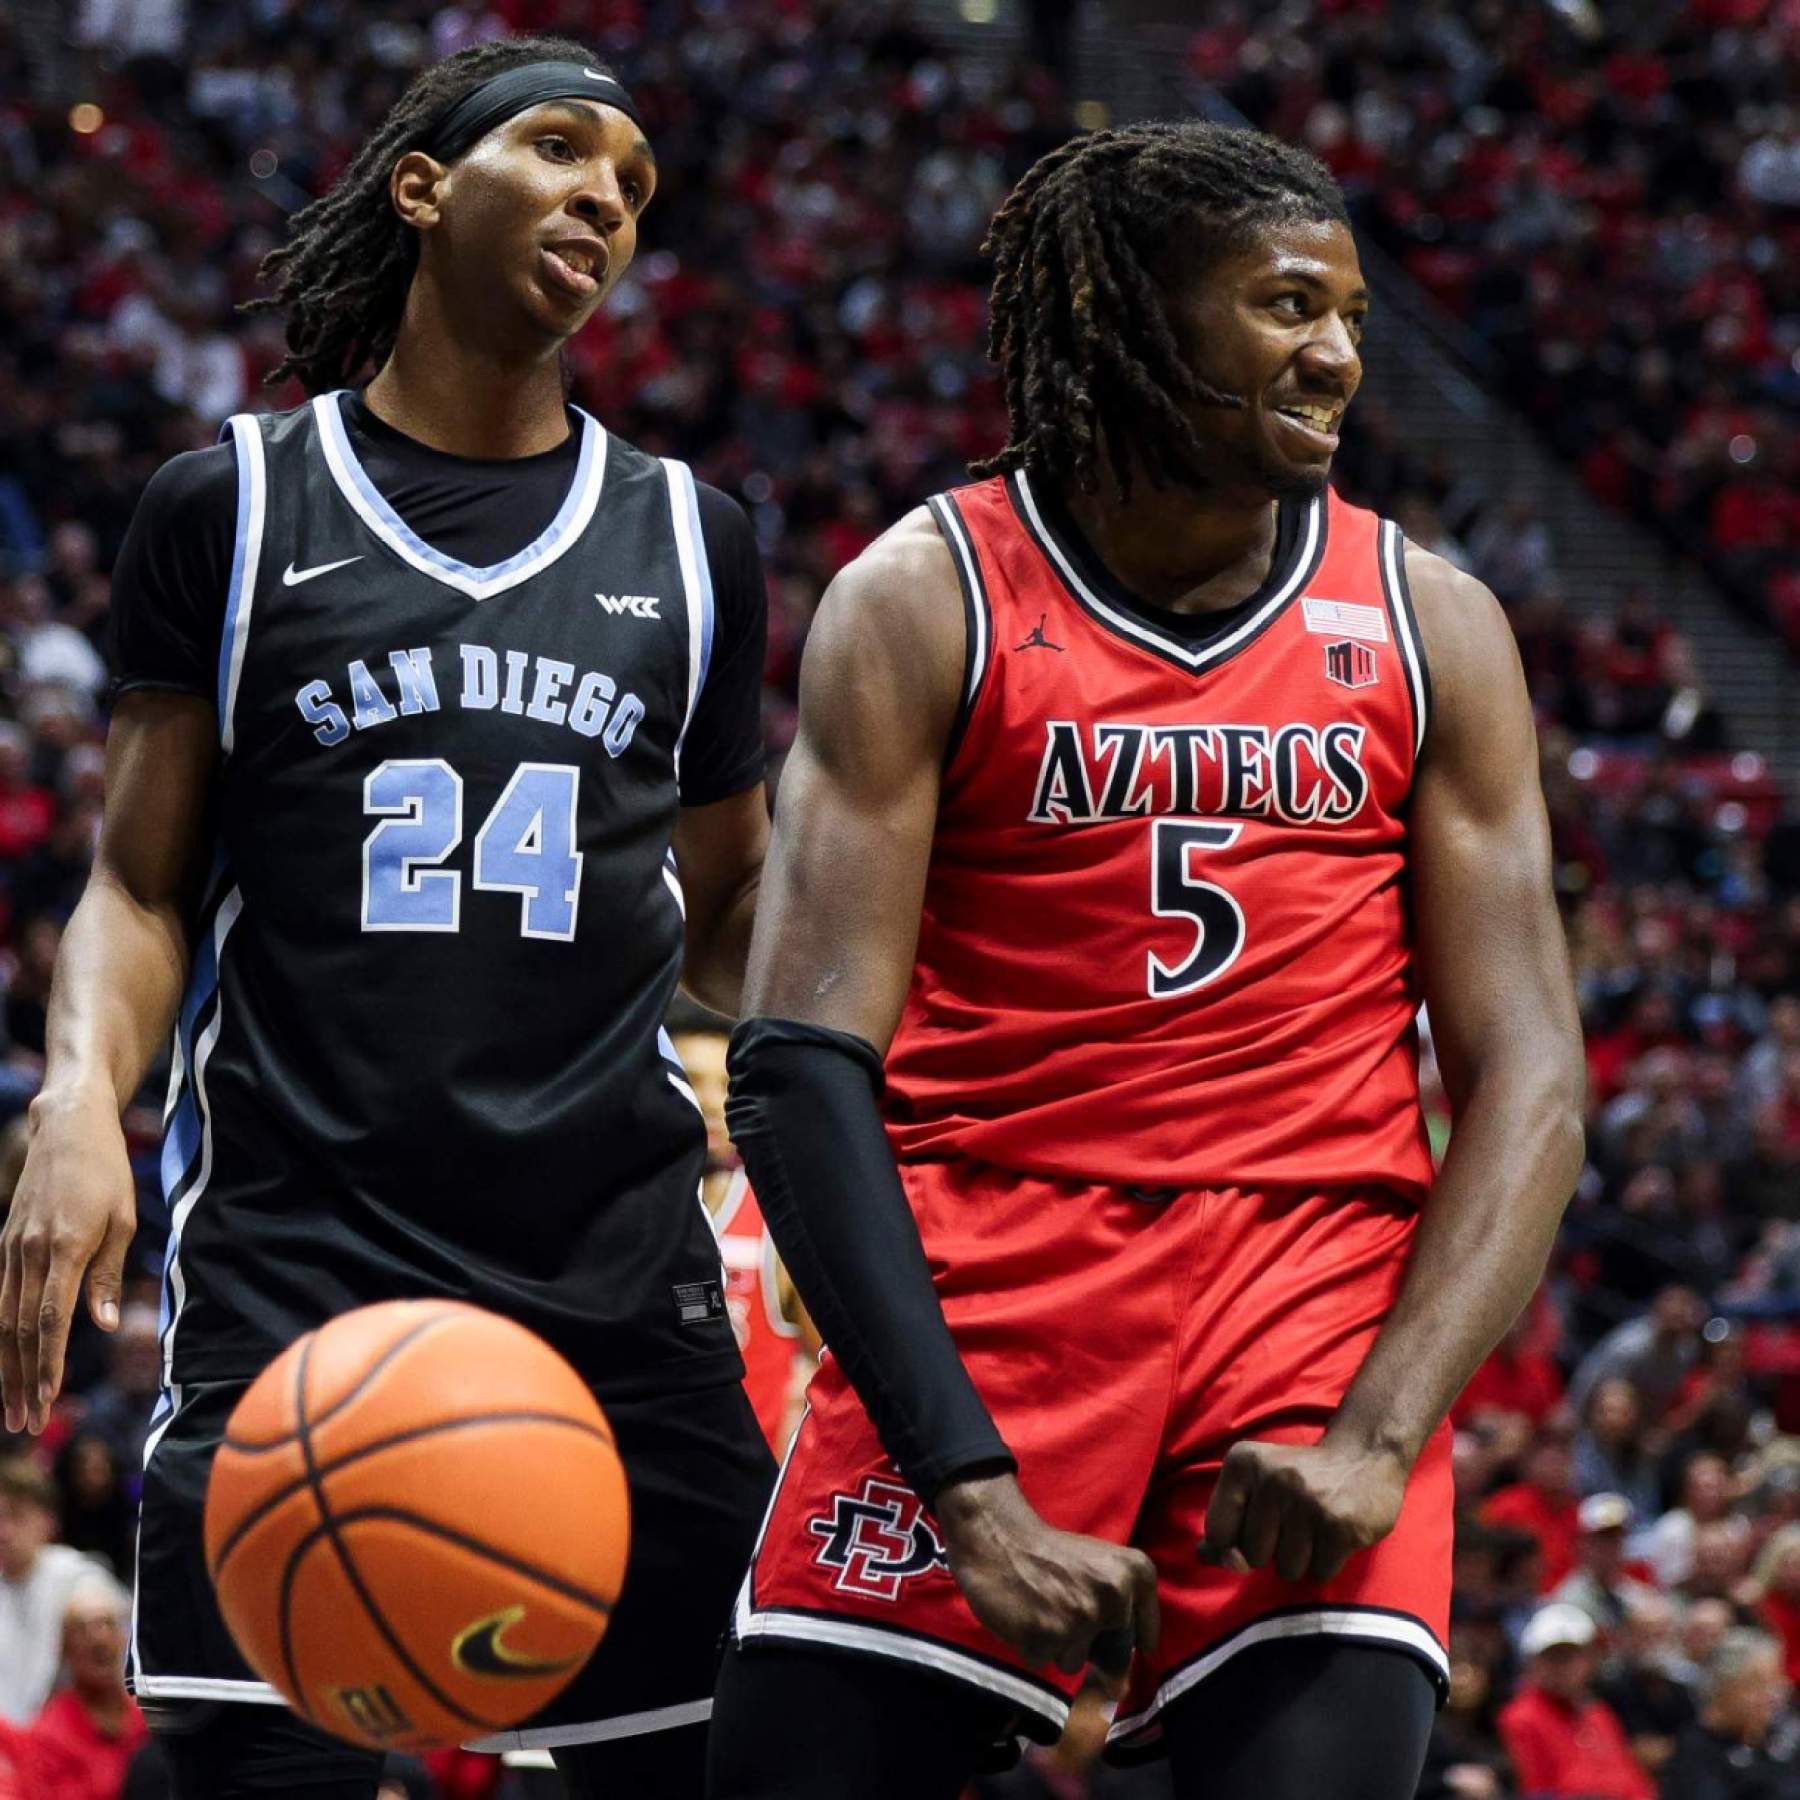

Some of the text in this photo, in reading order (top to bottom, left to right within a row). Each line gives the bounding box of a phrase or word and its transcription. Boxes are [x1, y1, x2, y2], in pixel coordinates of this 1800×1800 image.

[594, 593, 662, 620] WCC
[295, 643, 646, 759] SAN DIEGO
[1026, 720, 1370, 825] AZTECS
[360, 758, 584, 942] 24
[1147, 818, 1247, 999] 5
